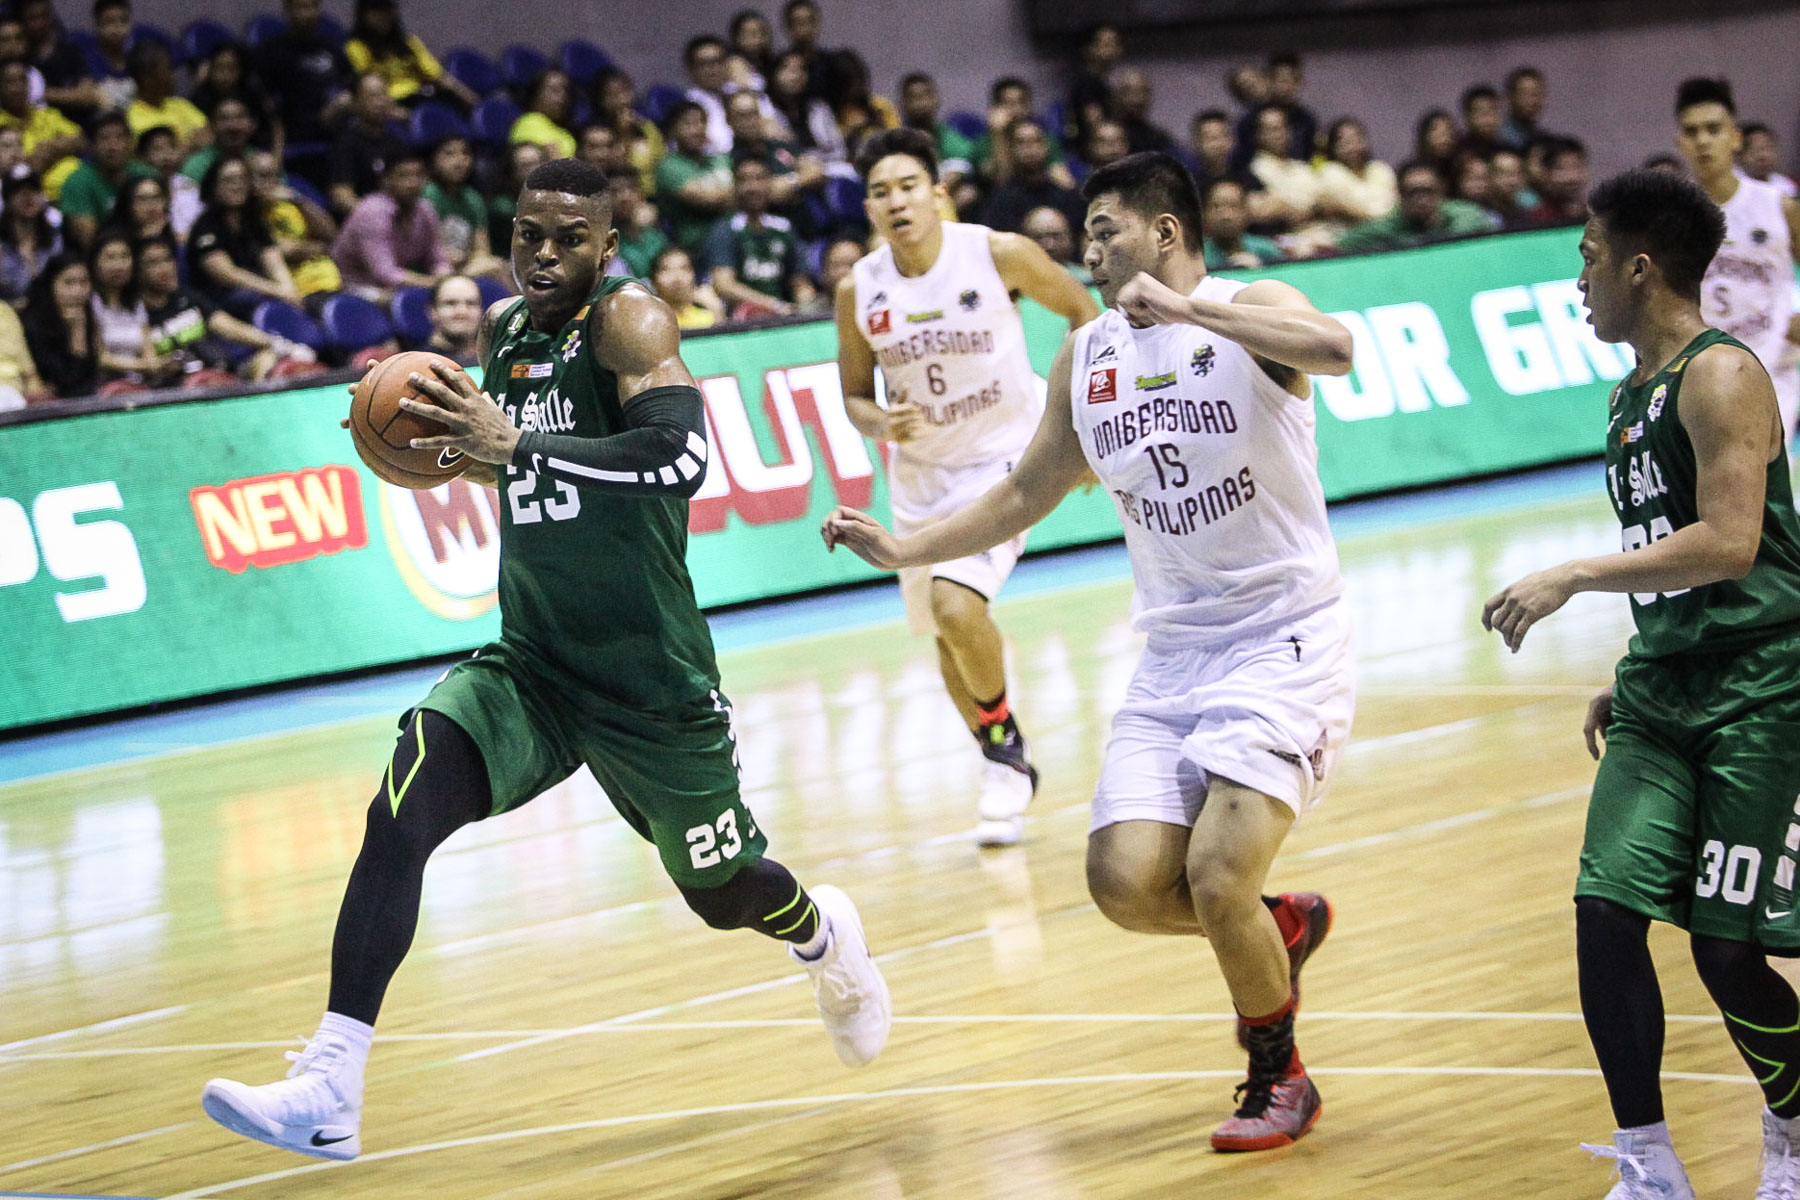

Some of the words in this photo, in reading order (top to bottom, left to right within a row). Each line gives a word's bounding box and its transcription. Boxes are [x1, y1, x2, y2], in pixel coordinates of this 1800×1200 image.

[521, 387, 577, 434] Salle
[926, 362, 947, 396] 6
[195, 470, 349, 561] NEW
[1308, 300, 1471, 424] OR
[1471, 277, 1637, 397] GR
[1092, 397, 1238, 460] UNIBERSIDAD
[506, 464, 581, 525] 23
[1143, 442, 1190, 490] 15
[1142, 466, 1256, 536] PILIPINAS
[685, 807, 742, 870] 23
[1695, 839, 1763, 906] 30
